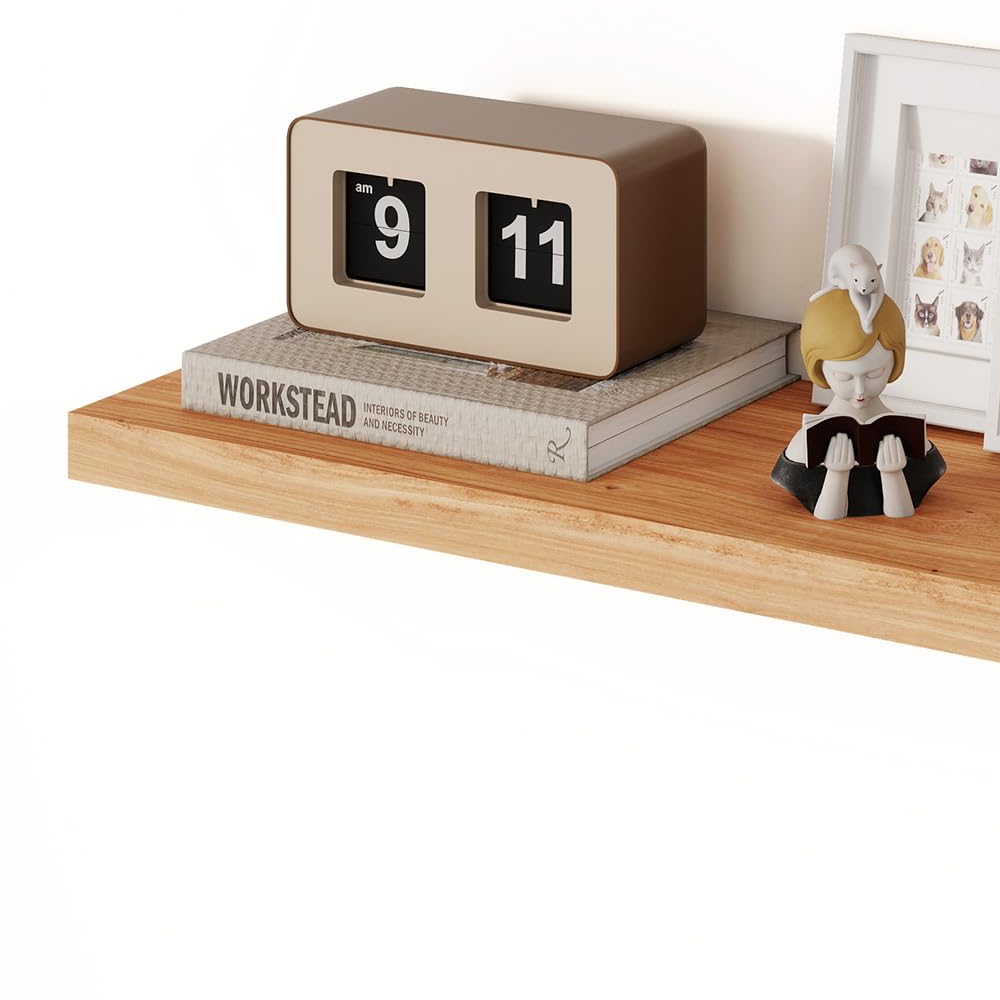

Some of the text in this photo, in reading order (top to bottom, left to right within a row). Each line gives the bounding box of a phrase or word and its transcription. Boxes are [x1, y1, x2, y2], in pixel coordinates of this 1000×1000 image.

[355, 182, 374, 195] am
[374, 195, 411, 260] 9
[502, 214, 565, 286] 11
[217, 372, 357, 428] WORKSTEAD
[363, 402, 449, 427] INTERIORS OF BEAUTY
[363, 417, 425, 437] AND NECESSITY
